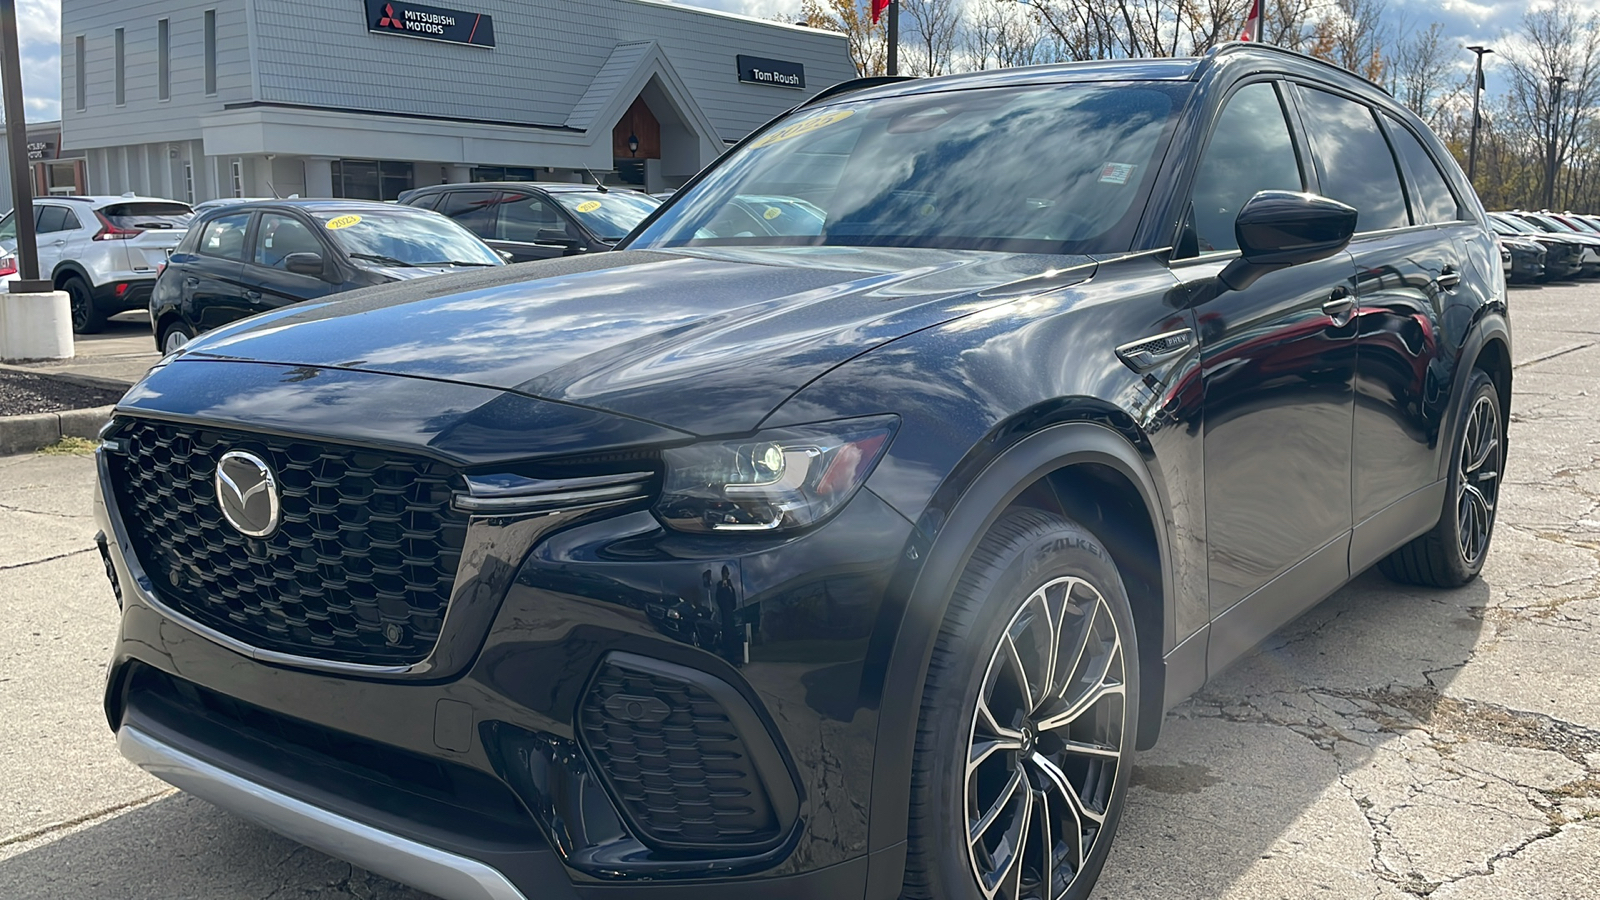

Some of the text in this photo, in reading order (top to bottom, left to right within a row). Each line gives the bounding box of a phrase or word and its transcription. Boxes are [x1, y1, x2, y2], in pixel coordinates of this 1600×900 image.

[404, 10, 455, 26] MITSUBISHI
[405, 21, 444, 34] MOTORS
[753, 69, 799, 85] Tom Roush
[760, 112, 838, 147] 2025
[332, 215, 356, 228] 2023
[1168, 334, 1188, 346] PHEV
